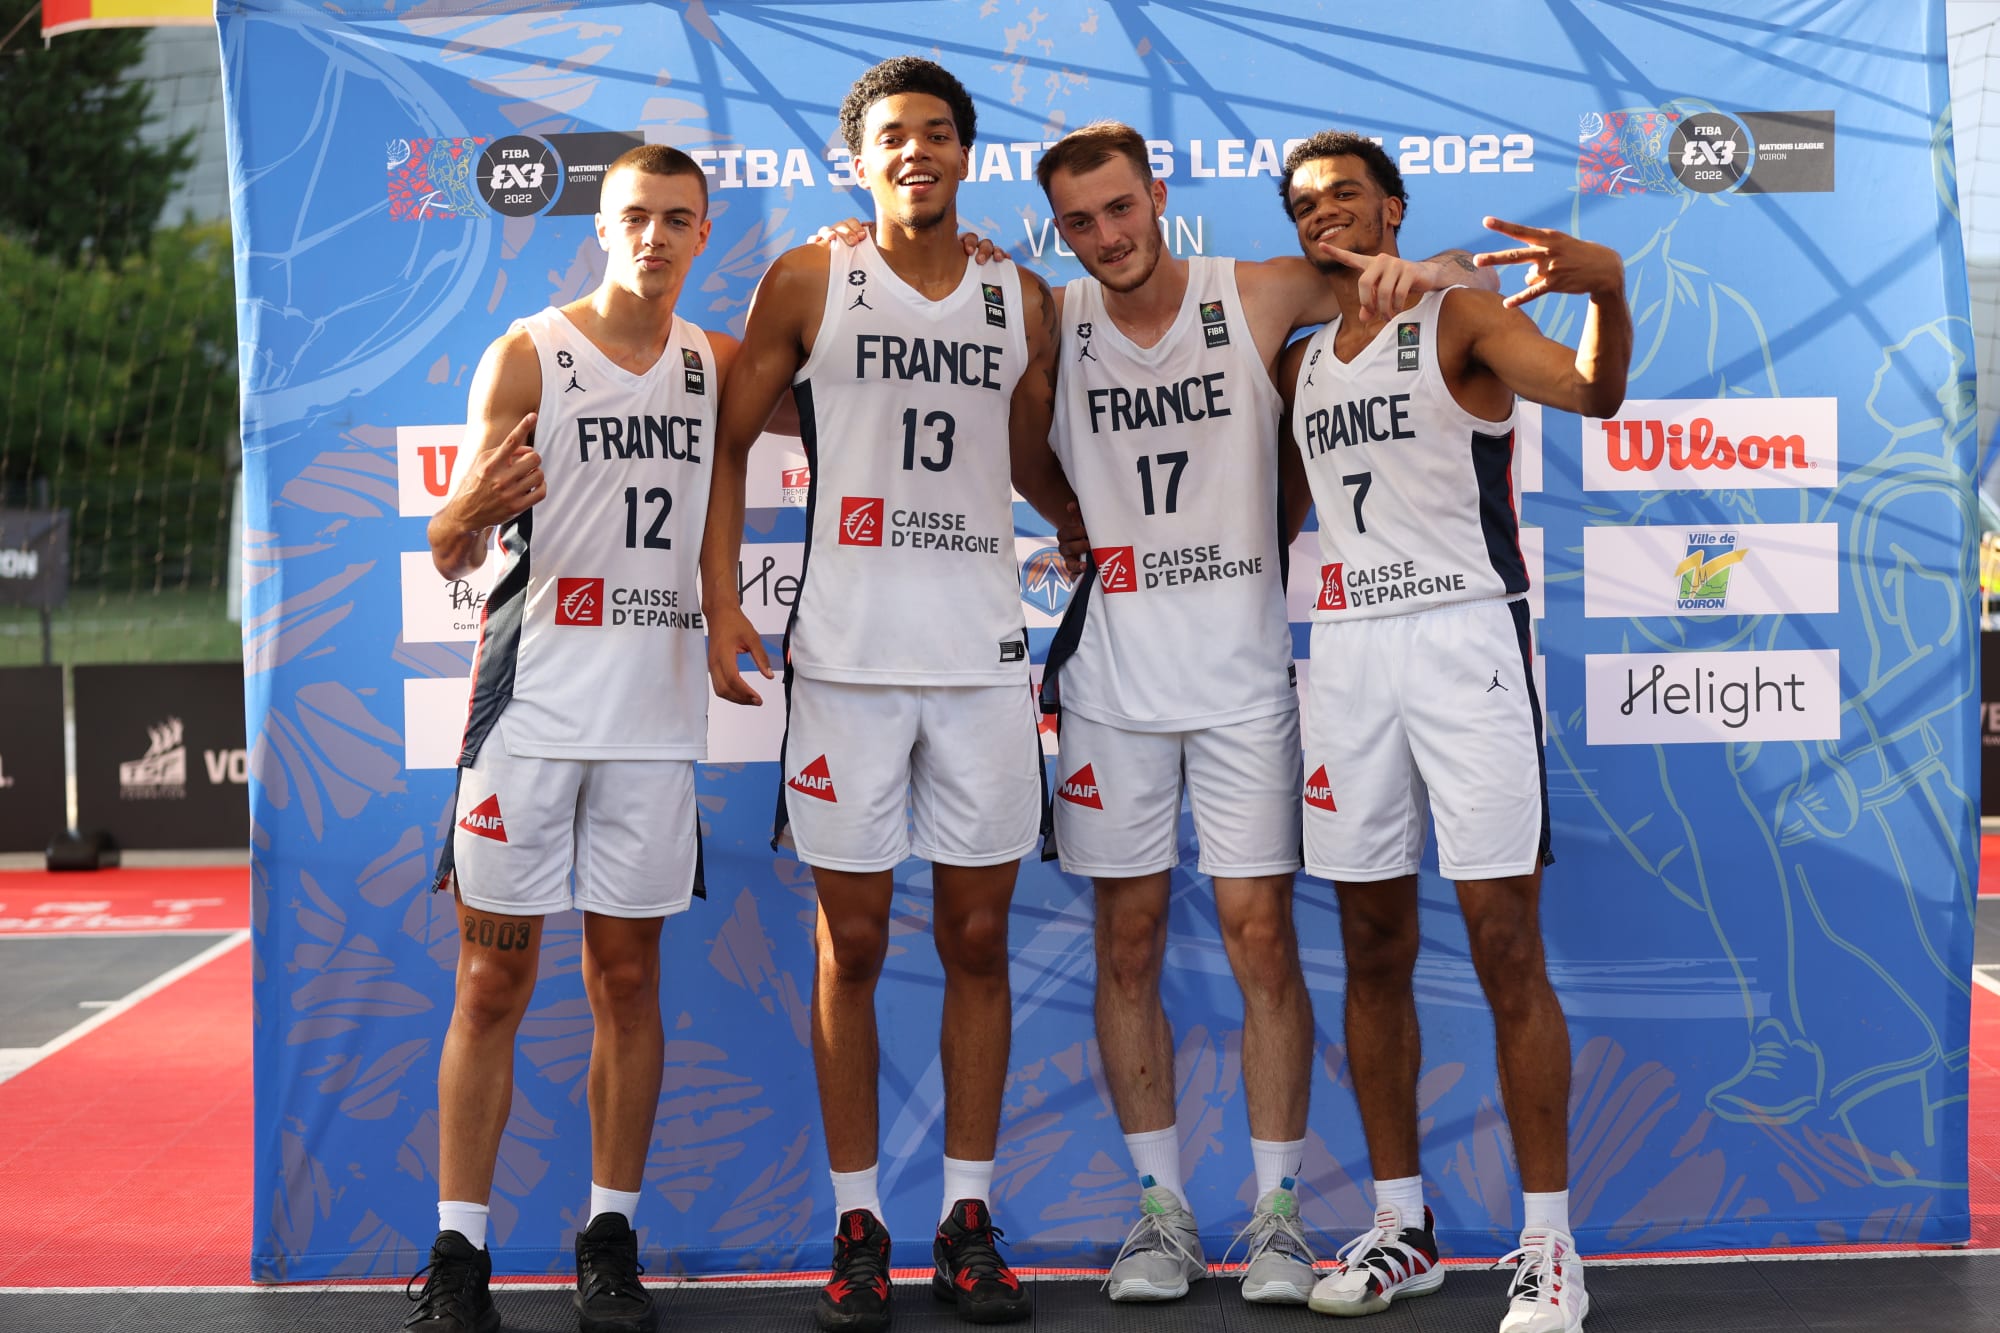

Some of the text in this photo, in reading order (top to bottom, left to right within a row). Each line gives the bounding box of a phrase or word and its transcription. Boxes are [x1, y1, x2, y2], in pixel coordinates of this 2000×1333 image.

[1694, 126, 1722, 136] FIBA
[502, 149, 530, 160] FIBA
[1758, 142, 1825, 151] NATIONS LEAGUE
[691, 149, 815, 188] FIBA
[1399, 134, 1534, 175] 2022
[1758, 153, 1787, 161] VOIRON
[568, 164, 603, 173] NATIONS
[1695, 170, 1722, 180] 2022
[504, 193, 532, 204] 2022
[1207, 326, 1225, 337] FIBA
[856, 334, 1003, 391] FRANCE
[1400, 350, 1416, 360] FIBA
[1087, 371, 1232, 434] FRANCE
[1305, 393, 1416, 460] FRANCE
[577, 415, 702, 464] FRANCE
[902, 407, 956, 472] 13
[1601, 417, 1809, 472] Wilson
[1136, 451, 1189, 516] 17
[1342, 471, 1372, 534] 7
[624, 486, 673, 550] 12
[891, 510, 966, 531] CAISSE
[1688, 533, 1735, 545] Ville de
[1142, 544, 1222, 569] CAISSE
[1347, 560, 1417, 588] CAISSE
[612, 588, 678, 608] CAISSE
[1677, 598, 1725, 609] VOIRON
[1620, 664, 1805, 729] Helight
[795, 774, 831, 790] MAIF
[1062, 782, 1098, 798] MAIF
[465, 814, 503, 830] MAIF
[464, 915, 531, 951] 2003
